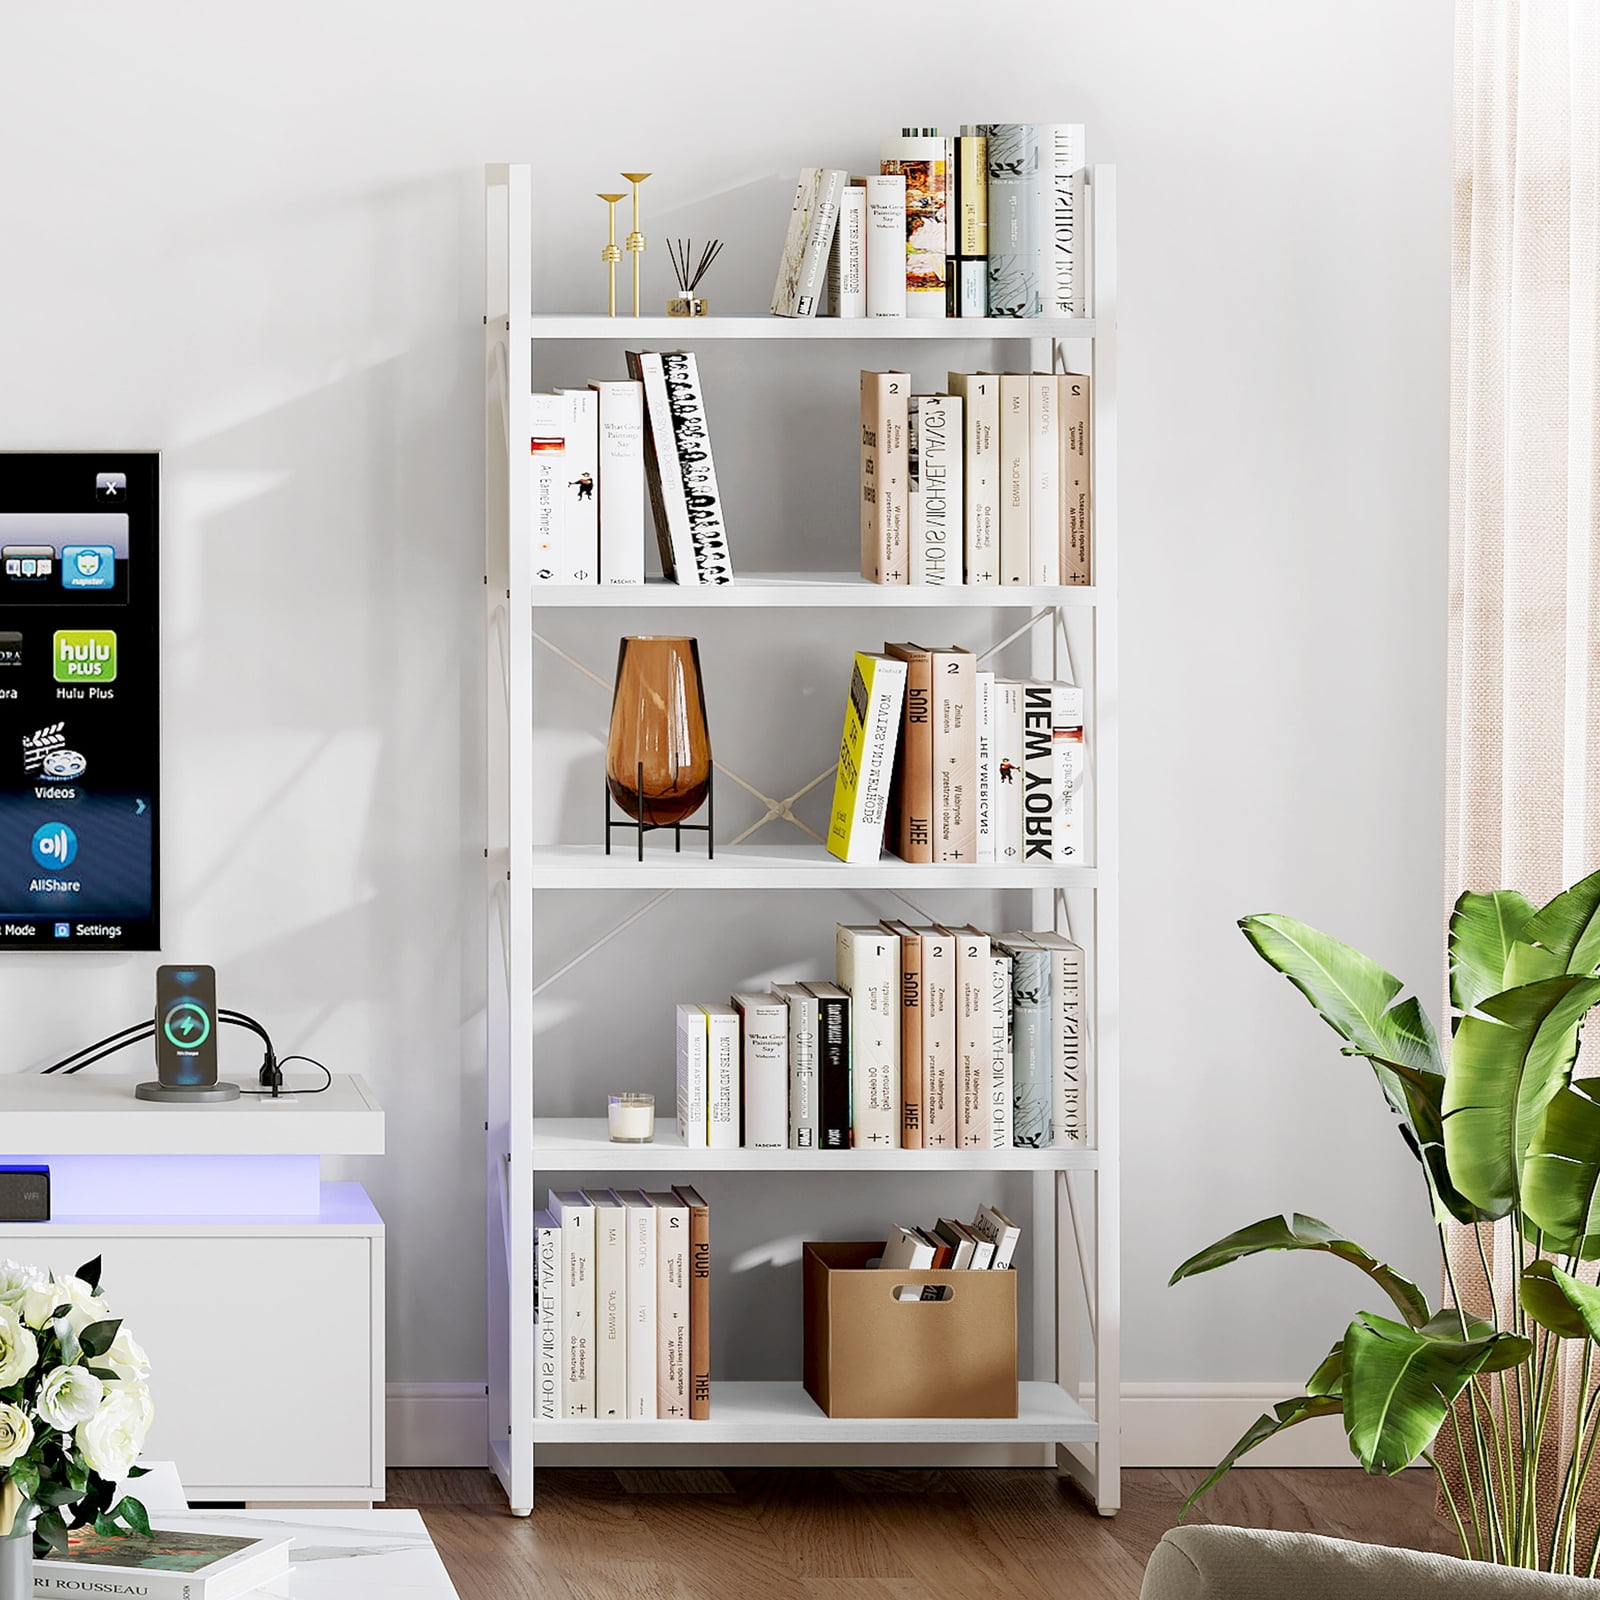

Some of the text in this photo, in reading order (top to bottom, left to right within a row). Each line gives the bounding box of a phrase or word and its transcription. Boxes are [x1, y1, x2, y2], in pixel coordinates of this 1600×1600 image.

[849, 208, 859, 294] MOVIES AND METHODS
[889, 383, 899, 394] 2
[978, 385, 985, 395] 1
[540, 465, 552, 535] An Eames Primer
[985, 506, 991, 516] Od
[893, 513, 901, 546] labiryncie
[60, 638, 110, 661] hulu
[68, 663, 102, 675] PLUS
[947, 663, 960, 674] 2
[56, 688, 114, 699] Hulu Plus
[955, 704, 963, 729] Zmiana
[35, 787, 76, 799] Videos
[942, 771, 950, 809] przestrzeni
[952, 793, 962, 826] labiryncie
[29, 879, 81, 892] AllShare
[5, 925, 36, 936] Mode
[76, 924, 122, 938] Settings
[933, 947, 943, 957] 2
[968, 947, 978, 957] 2
[993, 971, 1005, 1149] WHO IS MICHAEL JANG?
[720, 1037, 730, 1122] MOVIES AND METHODS
[573, 1216, 581, 1227] 1
[696, 1243, 709, 1279] PUUR
[578, 1338, 586, 1381] Od dekoracji
[696, 1373, 709, 1401] THEE
[56, 1579, 149, 1596] ROUSSEAU
